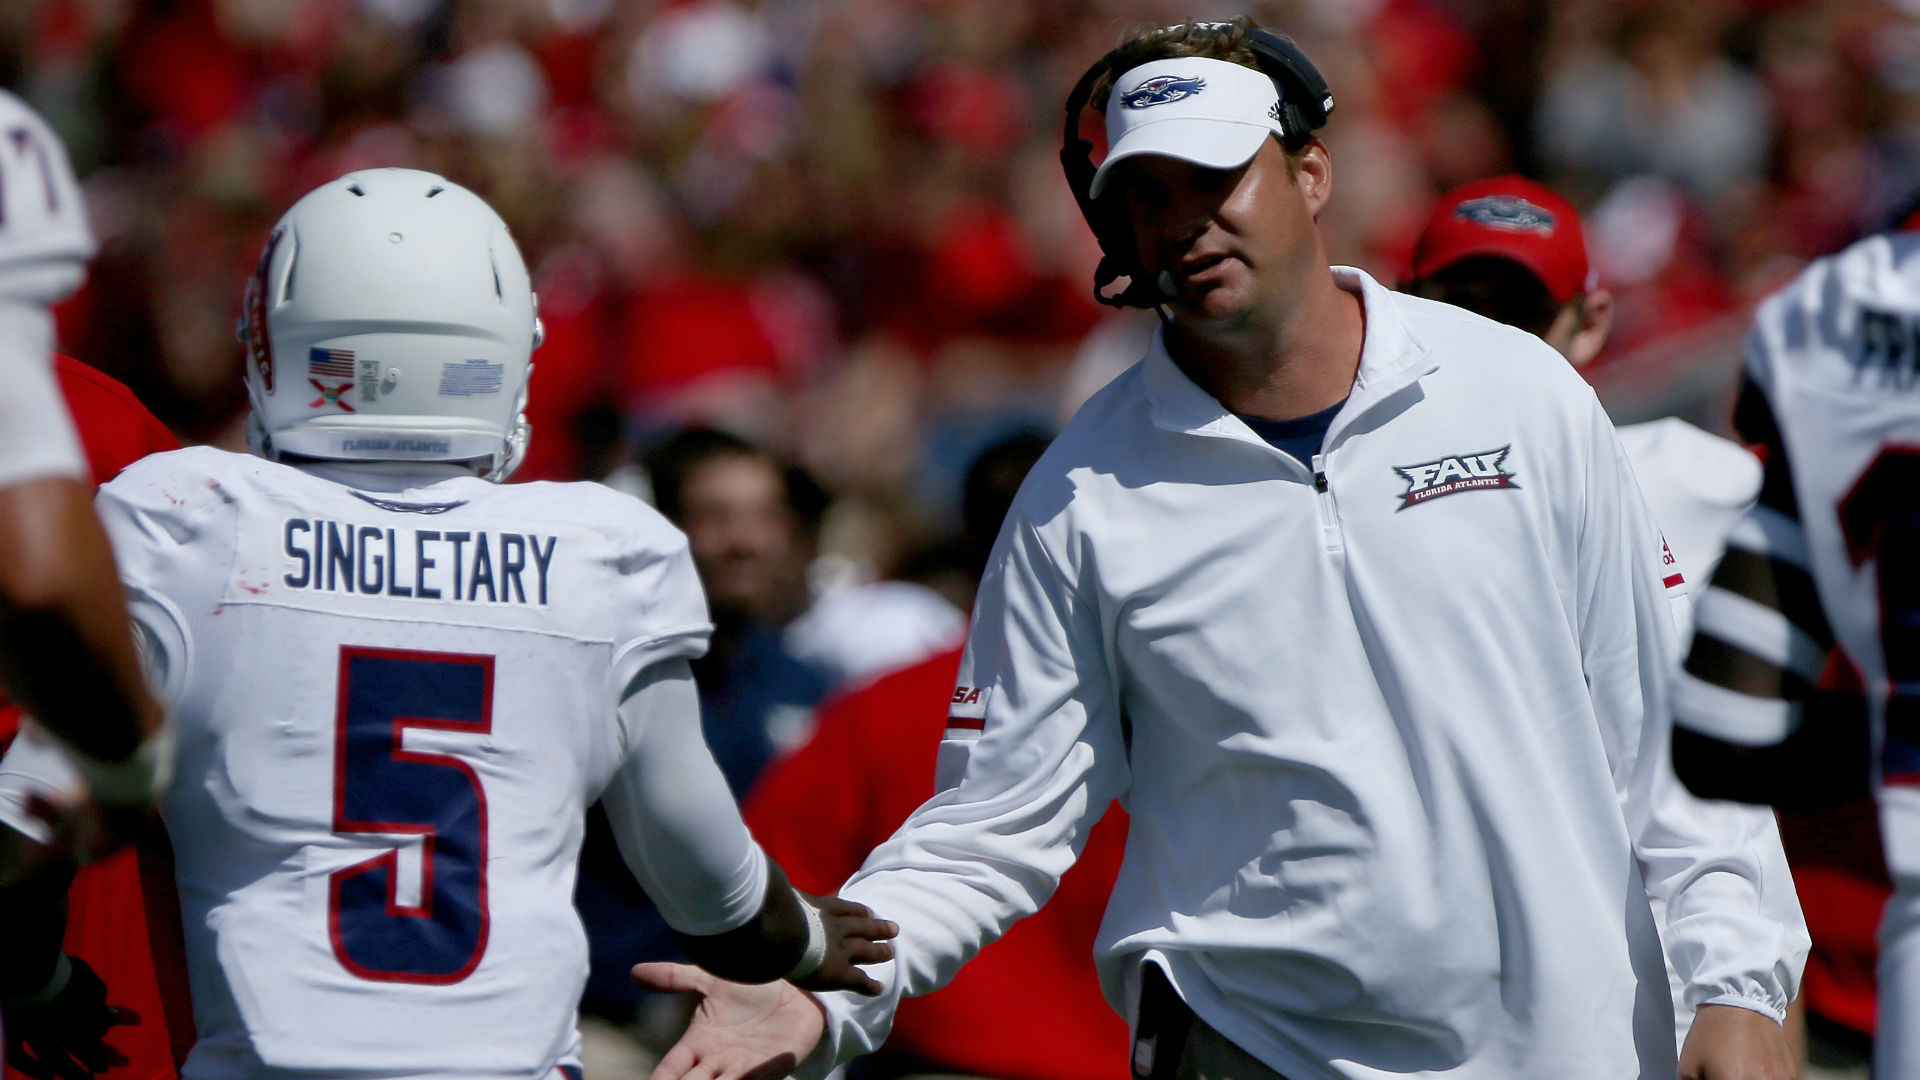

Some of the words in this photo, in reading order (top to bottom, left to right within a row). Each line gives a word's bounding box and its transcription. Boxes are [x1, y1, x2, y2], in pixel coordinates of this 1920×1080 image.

[1396, 446, 1509, 492] FAU
[1414, 483, 1453, 500] FLORIDA
[1454, 478, 1499, 489] ATLANTIC
[283, 518, 557, 605] SINGLETARY
[328, 644, 495, 986] 5
